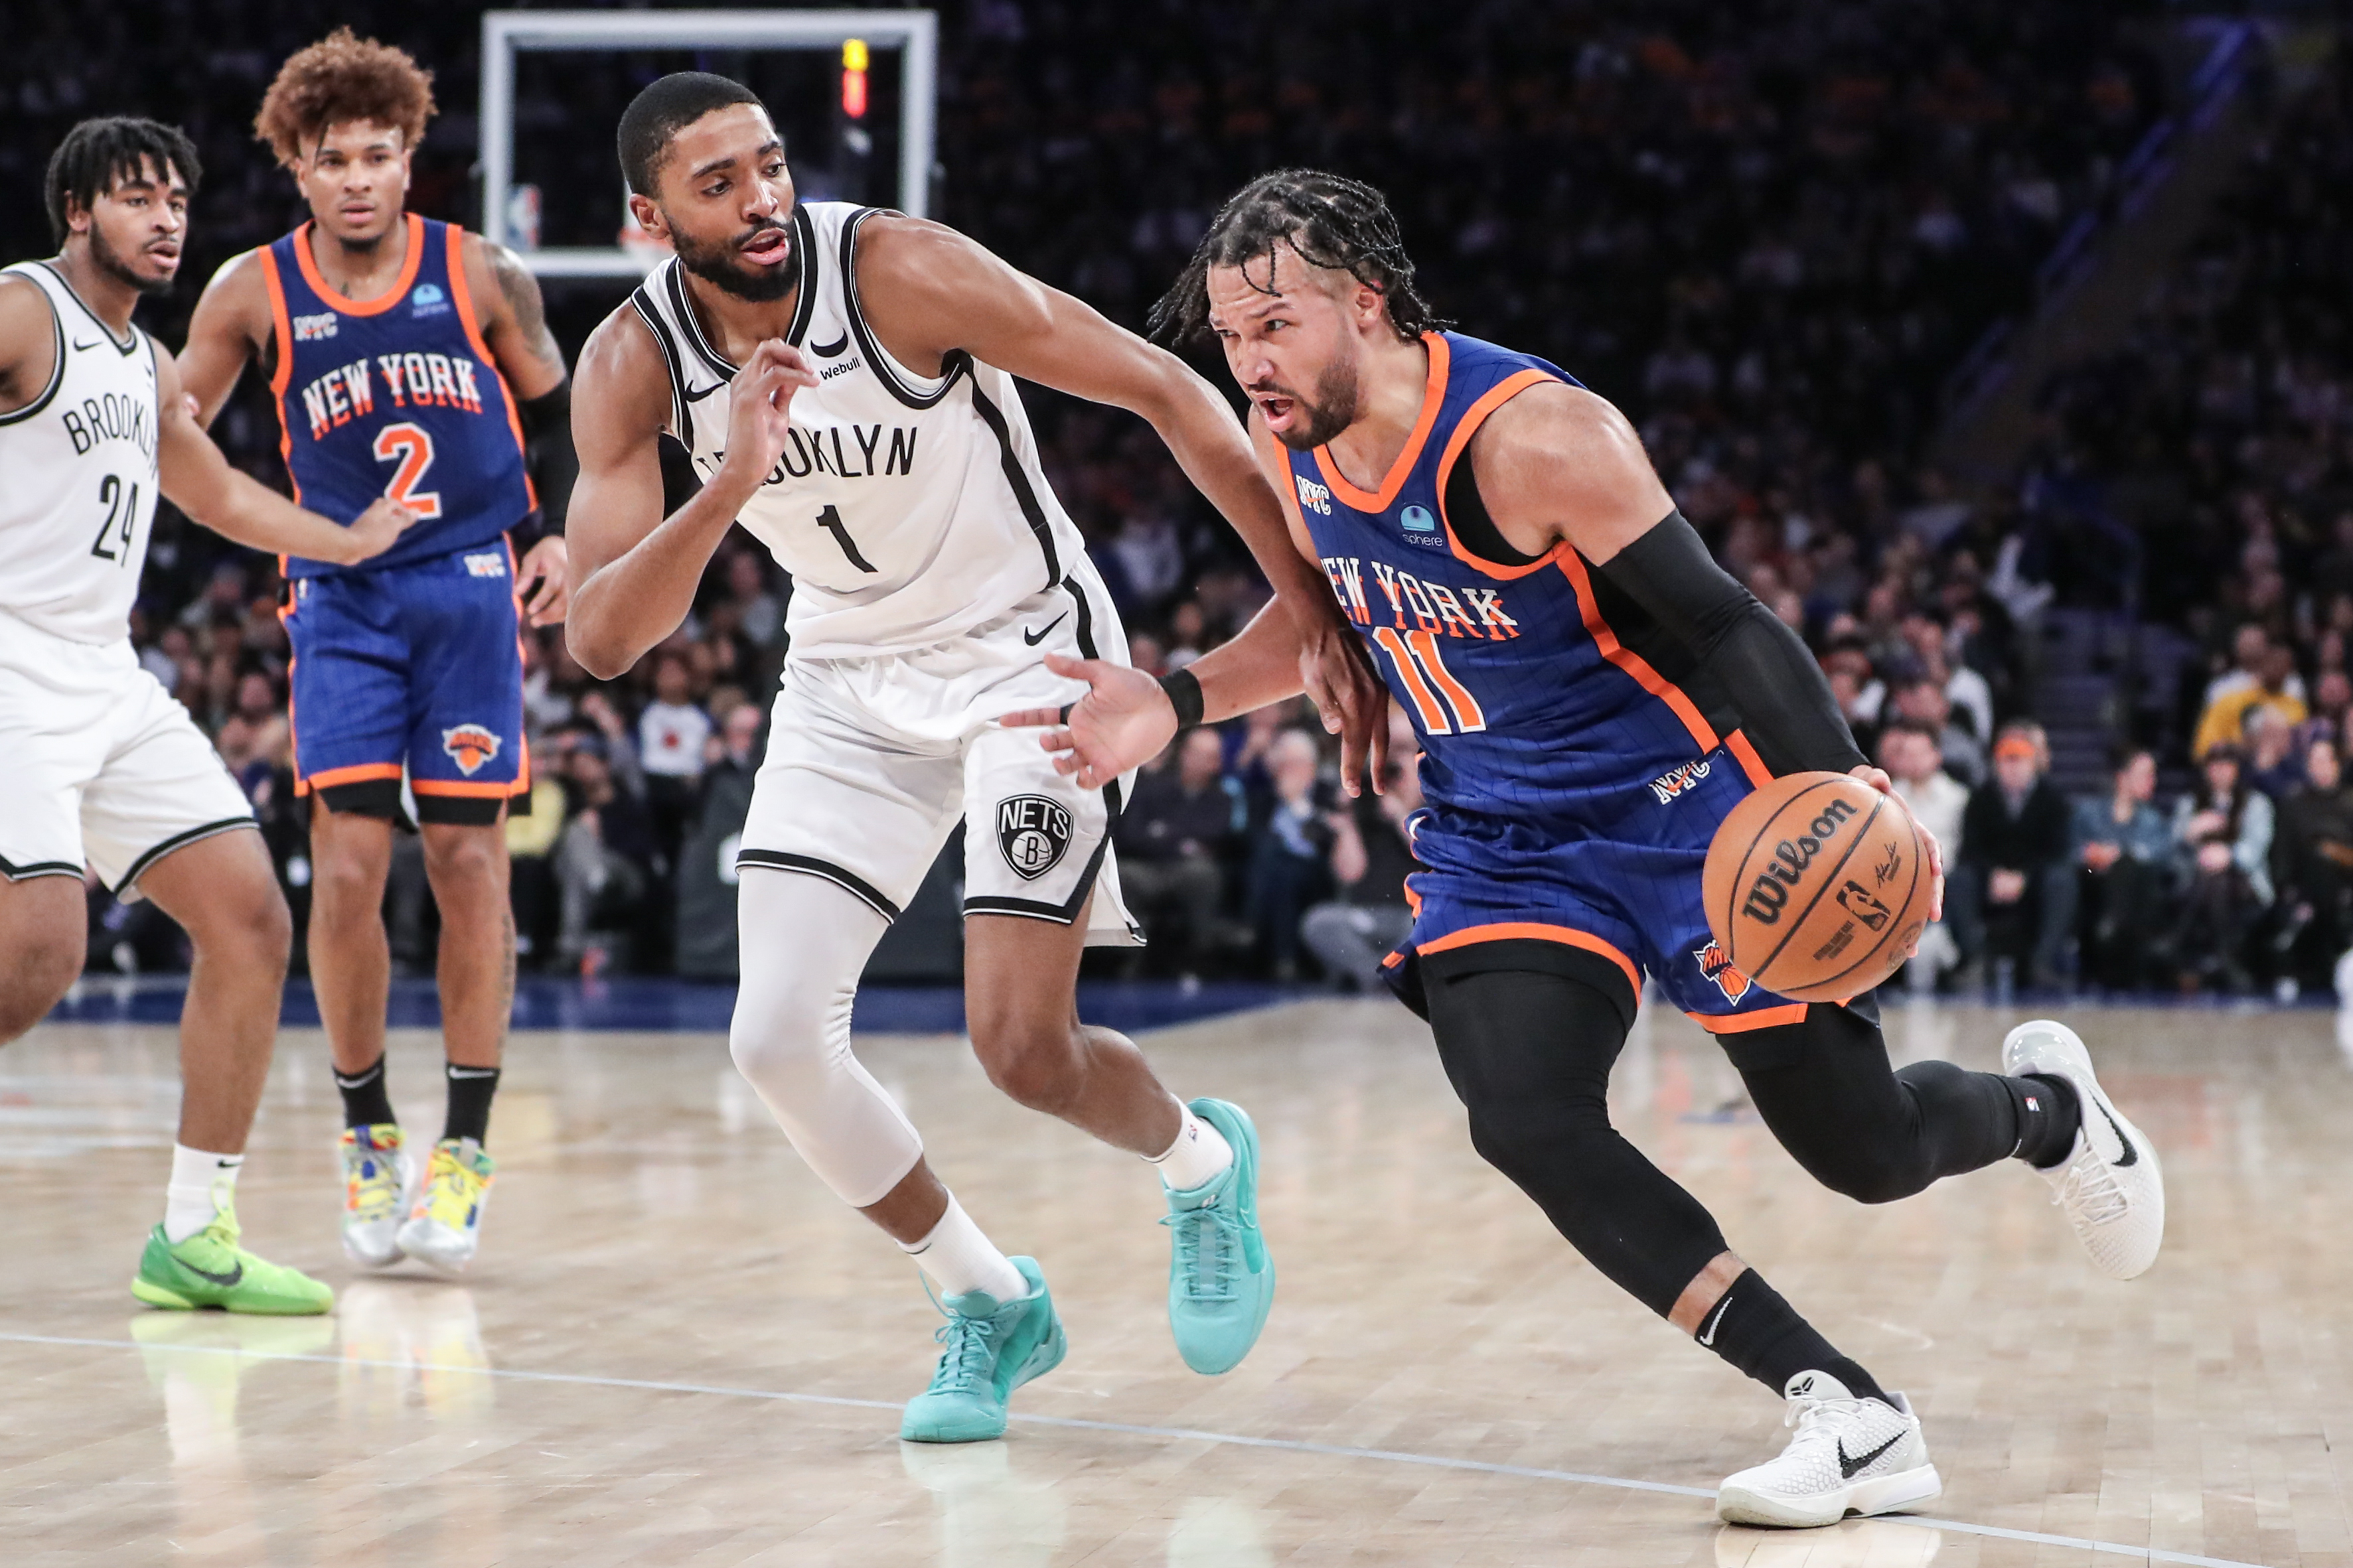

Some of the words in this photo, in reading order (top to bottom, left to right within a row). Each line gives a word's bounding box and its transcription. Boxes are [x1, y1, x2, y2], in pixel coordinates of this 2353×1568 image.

[303, 362, 375, 441] NEW
[377, 352, 483, 415] YORK
[820, 356, 861, 382] Webull
[374, 422, 441, 519] 2
[1296, 474, 1331, 516] NYC
[91, 473, 138, 567] 24
[816, 504, 879, 573] 1
[1402, 533, 1443, 547] sphere
[1321, 557, 1371, 625] EW
[1371, 561, 1521, 640] YORK
[1372, 626, 1486, 735] 11
[1648, 759, 1711, 805] NYC
[1001, 800, 1069, 840] NETS
[1025, 836, 1039, 865] B
[1741, 798, 1859, 926] Wilson
